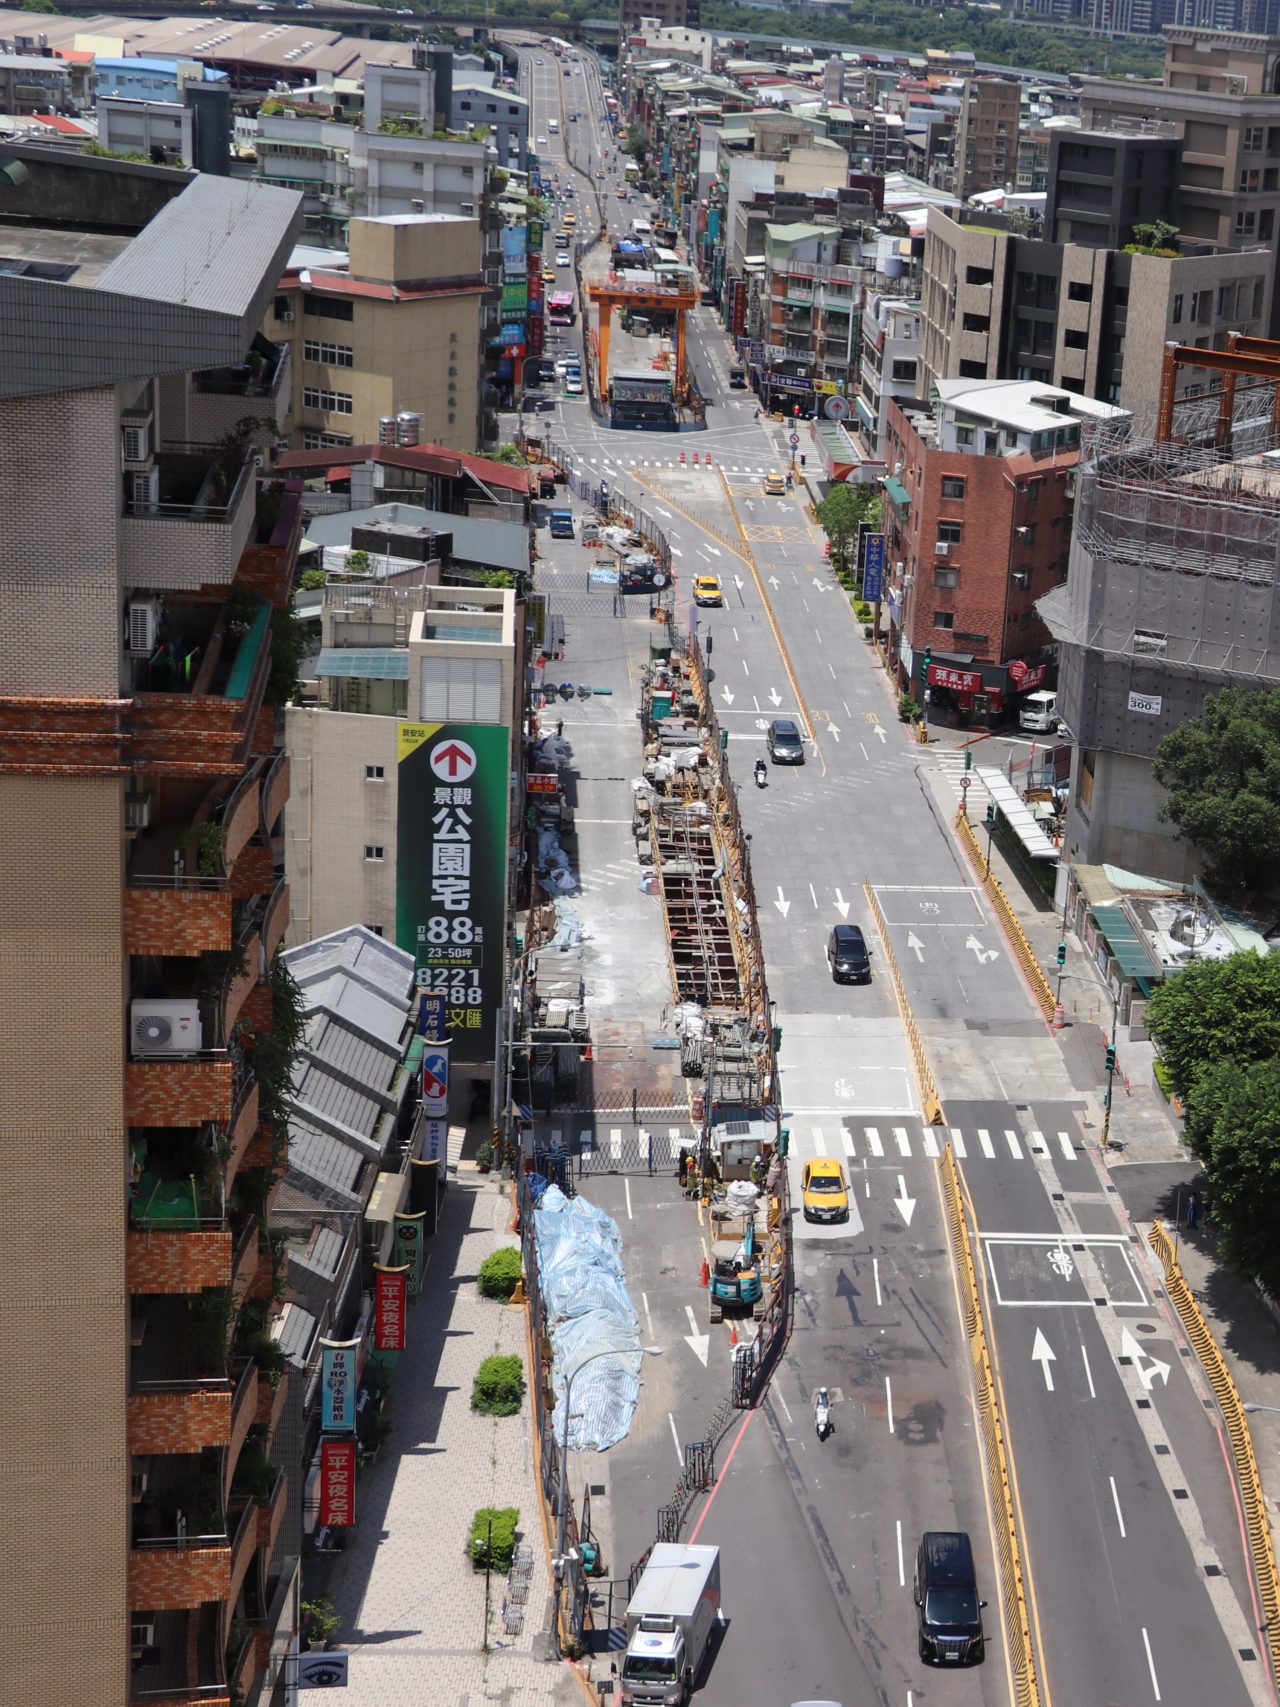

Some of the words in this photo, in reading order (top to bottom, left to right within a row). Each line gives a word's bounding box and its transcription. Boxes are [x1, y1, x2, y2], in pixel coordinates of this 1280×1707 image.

[1130, 700, 1152, 710] 300
[402, 728, 426, 738] 景安站
[433, 787, 472, 805] 景觀
[430, 807, 472, 911] 公園宅
[427, 916, 473, 944] 88
[428, 948, 472, 958] 23-50坪
[416, 967, 480, 986] 8221
[418, 986, 482, 1005] 88
[445, 1008, 482, 1028] 文匯
[381, 1286, 400, 1349] 平安夜名床
[327, 1456, 348, 1525] 平安夜名床
